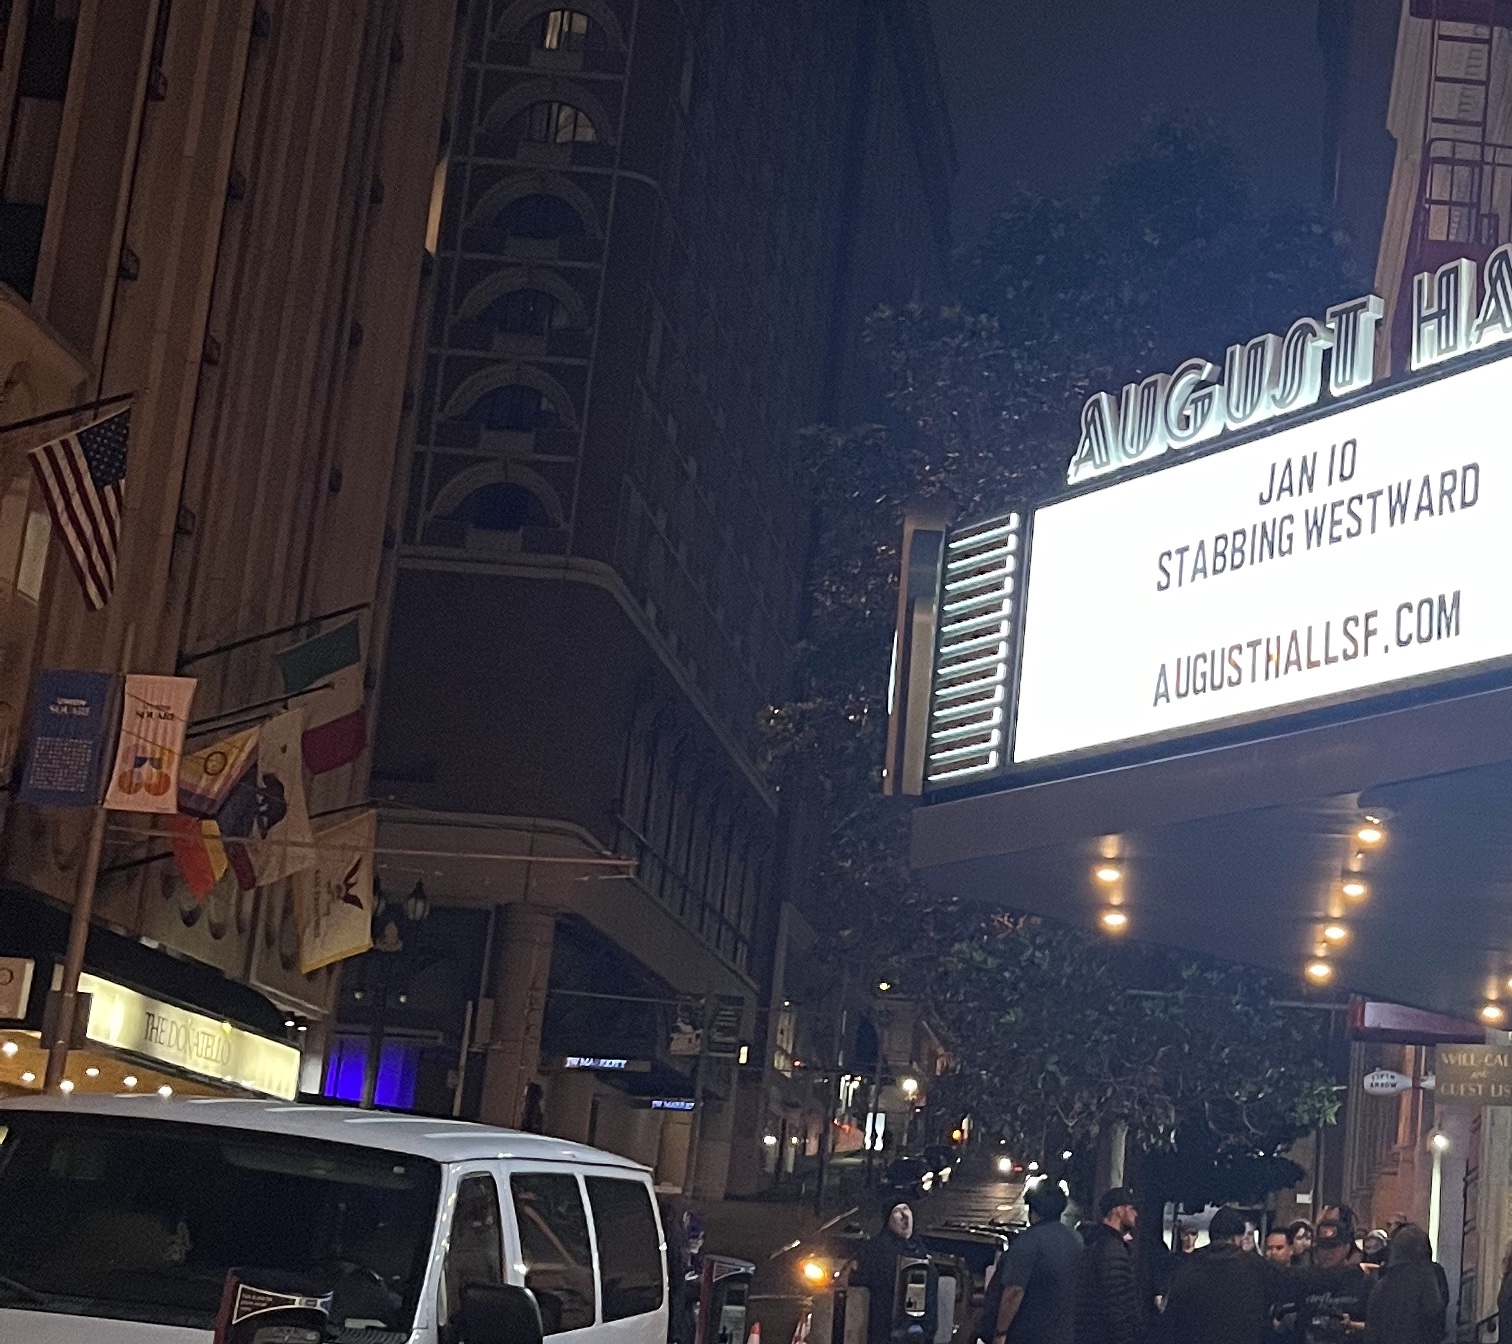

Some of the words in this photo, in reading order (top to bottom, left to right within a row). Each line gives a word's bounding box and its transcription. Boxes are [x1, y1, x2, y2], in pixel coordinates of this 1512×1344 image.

[1067, 293, 1385, 485] AUGUST
[1156, 513, 1295, 592] STABBING
[1304, 462, 1480, 551] WESTWARD
[1258, 451, 1318, 506] JAN
[1327, 438, 1357, 487] 10
[1152, 589, 1461, 708] AUGUSTHALLSF.COM
[144, 1011, 168, 1045] THE
[167, 1020, 231, 1066] DONATELLO
